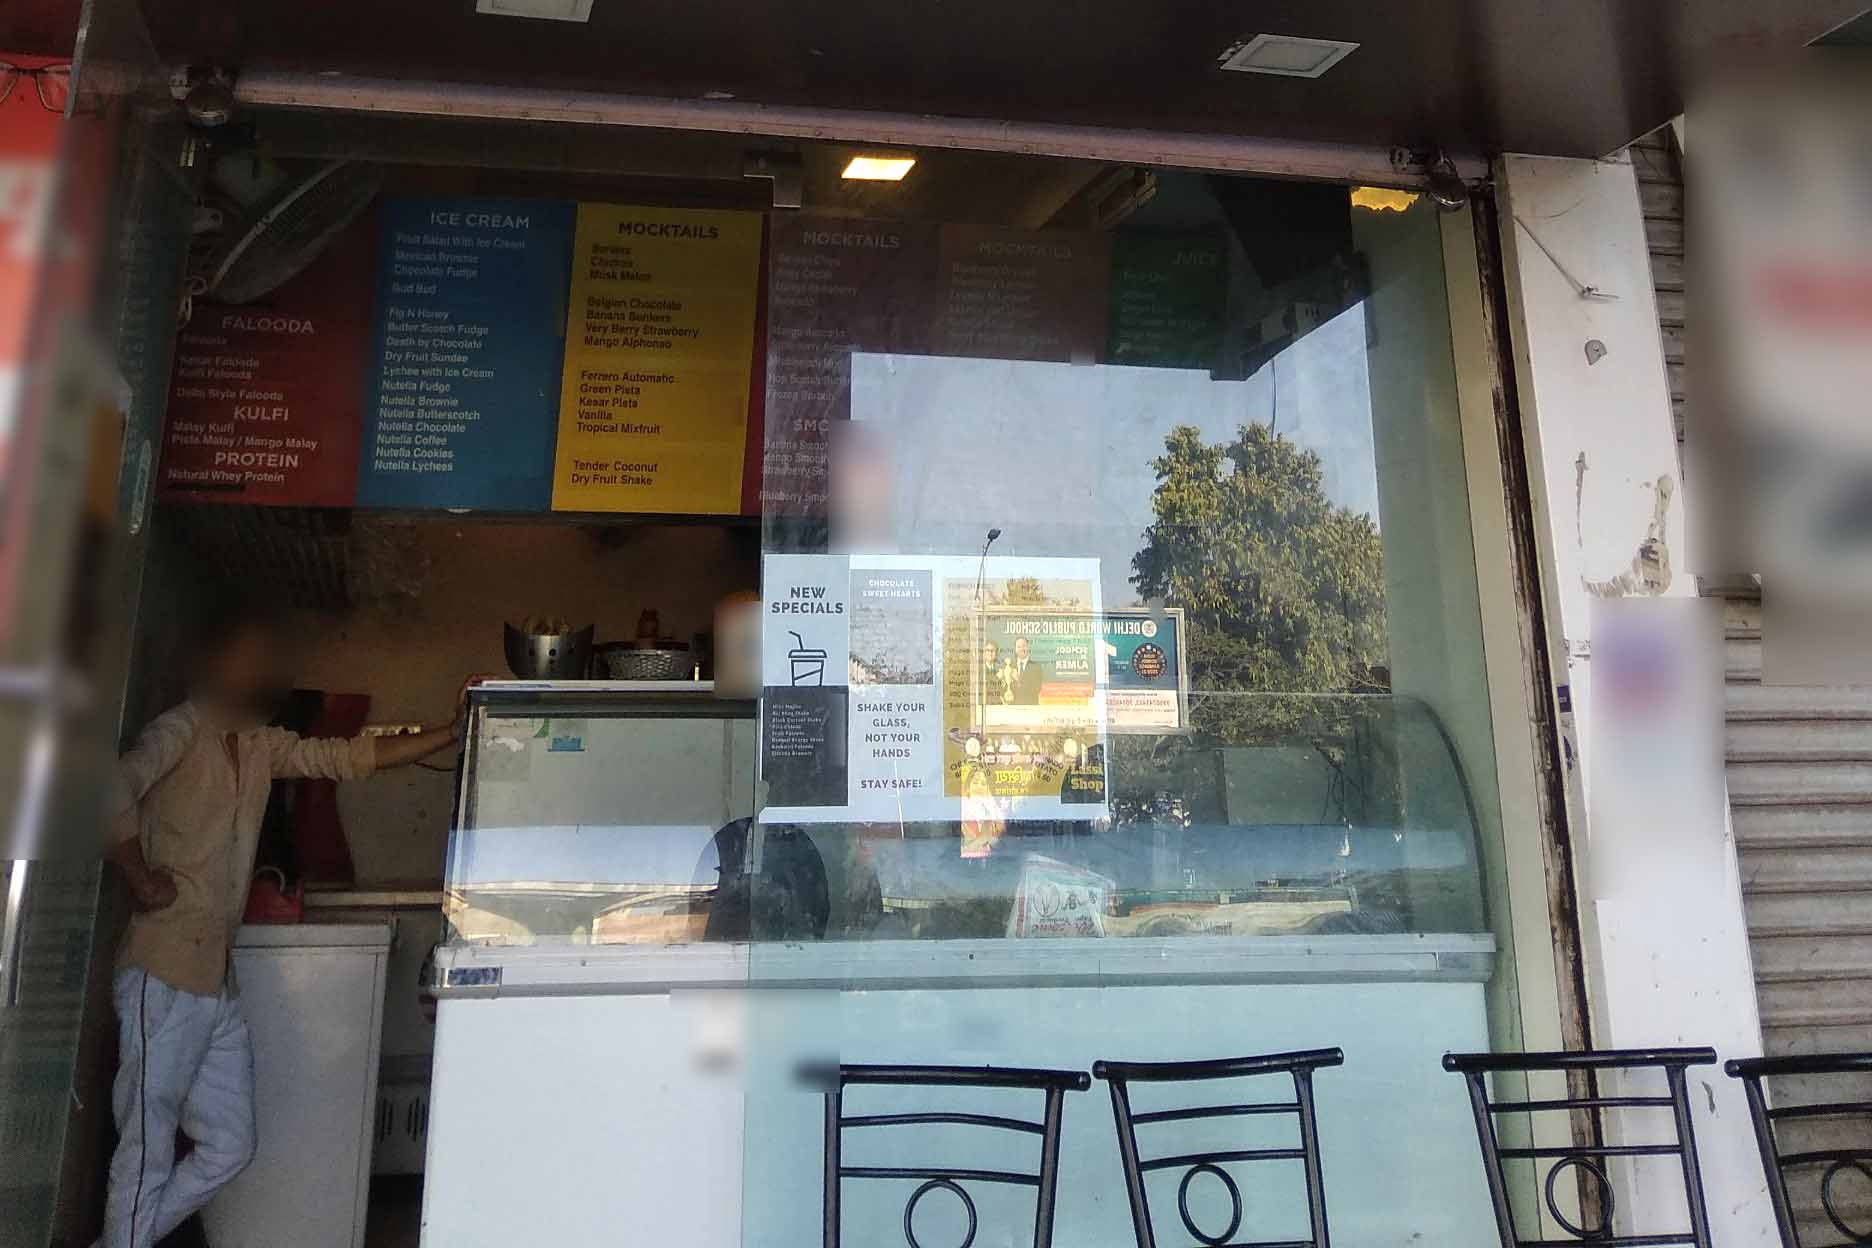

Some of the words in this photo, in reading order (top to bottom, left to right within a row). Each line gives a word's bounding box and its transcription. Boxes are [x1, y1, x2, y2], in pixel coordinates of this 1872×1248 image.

[430, 212, 461, 226] ICE
[465, 214, 529, 229] CREAM
[618, 222, 719, 239] MOCKTAILS
[803, 231, 901, 249] MOCKTAILS
[222, 316, 315, 334] FALOODA
[585, 322, 609, 335] Very
[385, 351, 403, 363] Dry
[405, 352, 429, 362] Fruit
[445, 368, 460, 377] Ice
[462, 368, 494, 378] Cream
[581, 370, 619, 381] Ferrero
[382, 381, 416, 392] Nutella
[420, 382, 450, 393] Fudge
[580, 383, 612, 394] Green
[614, 385, 641, 395] Pista
[381, 395, 415, 405] Nutella
[579, 397, 609, 407] Kesar
[612, 397, 638, 408] Pista
[234, 407, 289, 421] KULFI
[379, 408, 414, 419] Nutella
[417, 409, 480, 420] Butterscotch
[578, 409, 613, 420] Vanilla
[378, 422, 413, 432] Nutella
[415, 422, 466, 433] Chocolate
[576, 422, 618, 435] Tropical
[621, 423, 661, 435] Mixfruit
[376, 435, 412, 445] Nutella
[414, 435, 448, 446] Coffee
[376, 447, 411, 458] Nutella
[413, 448, 454, 458] Cookies
[215, 452, 300, 468] PROTEIN
[374, 460, 410, 471] Nutella
[574, 460, 609, 471] Tender
[613, 461, 658, 472] Coconut
[211, 471, 242, 483] Whey
[244, 472, 285, 483] Protein
[571, 473, 590, 485] Dry
[592, 474, 617, 485] Fruit
[620, 474, 653, 485] Shake
[869, 579, 914, 587] CHOCOLATE
[790, 586, 826, 599] NEW
[771, 602, 844, 614] SPECIALS
[857, 704, 893, 712] SHAKE
[895, 703, 926, 712] YOUR
[872, 718, 911, 728] GLASS,
[865, 733, 888, 742] NOT
[890, 733, 920, 742] YOUR
[872, 749, 911, 758] HANDS
[861, 779, 889, 789] STAY
[891, 779, 923, 789] SAFE!
[1070, 776, 1104, 792] Shop
